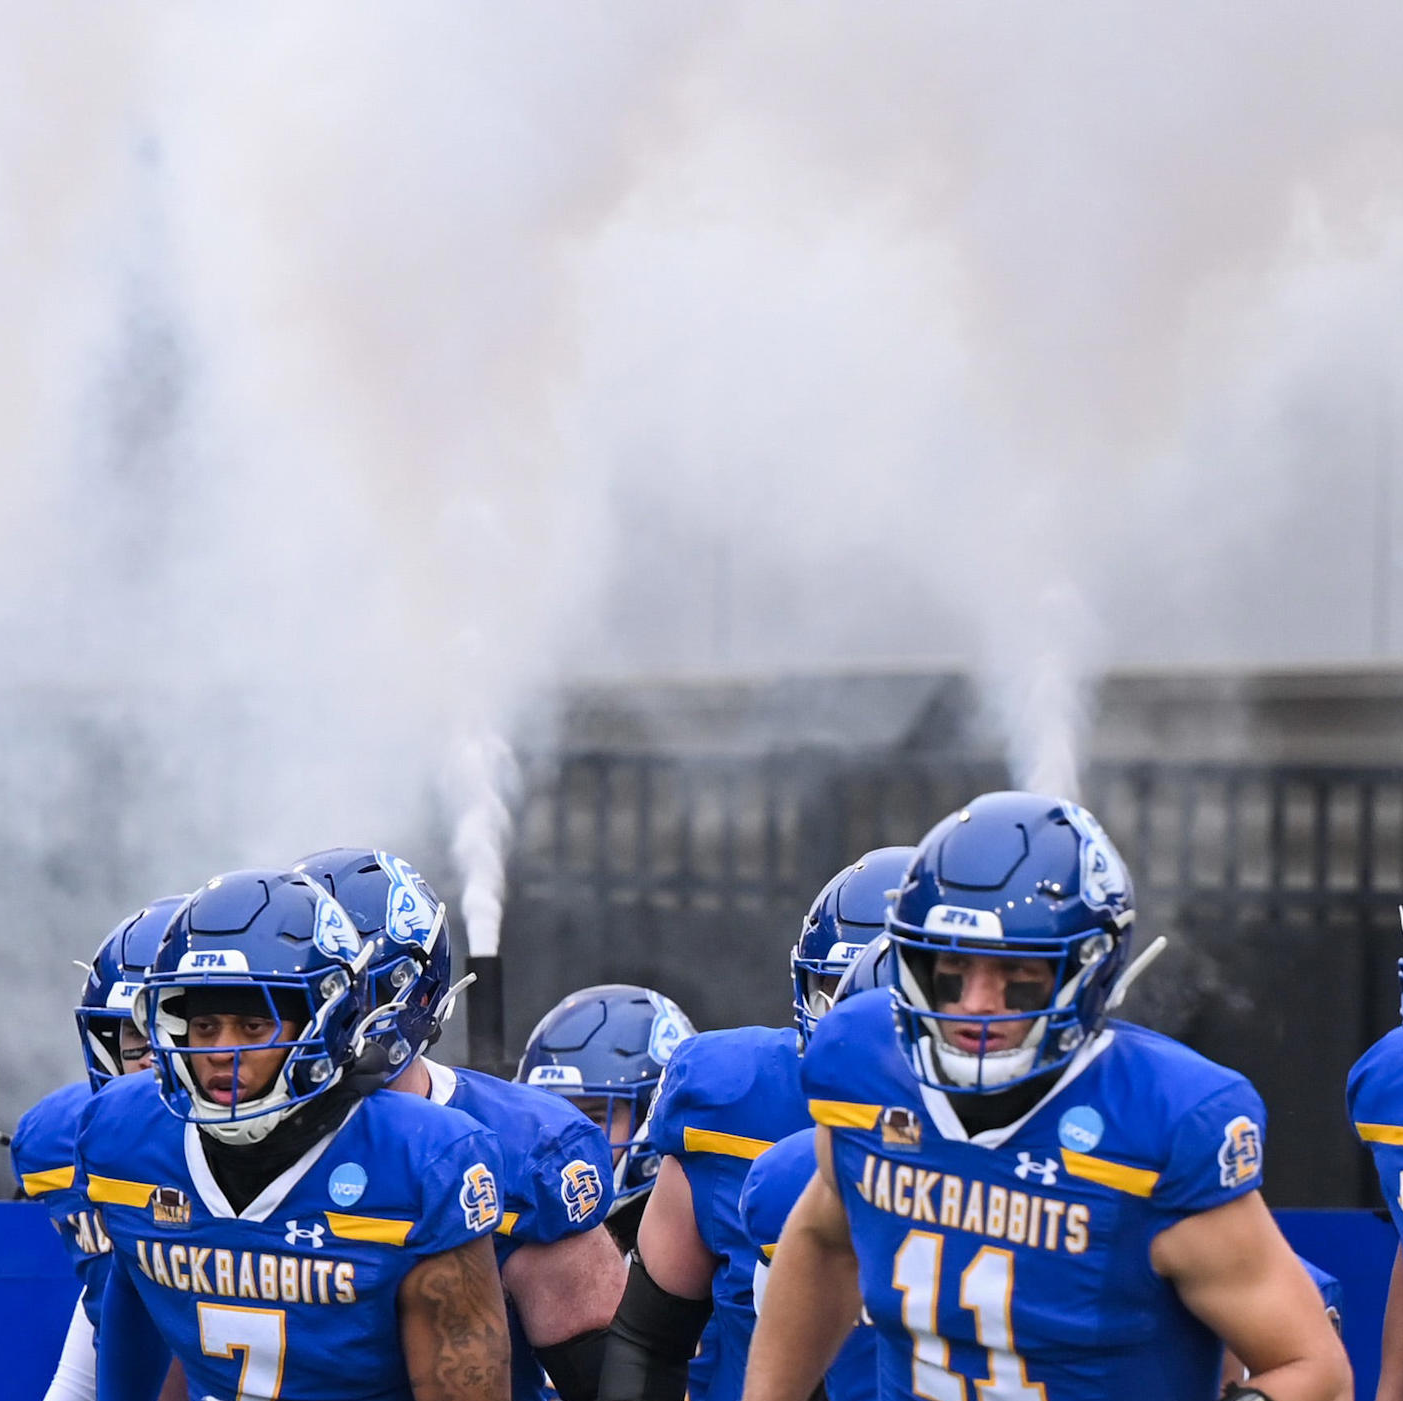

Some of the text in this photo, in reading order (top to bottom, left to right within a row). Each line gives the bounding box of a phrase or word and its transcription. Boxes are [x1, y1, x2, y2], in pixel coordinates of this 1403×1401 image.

[191, 954, 226, 967] JFPA
[856, 1155, 1090, 1254] JACKRABBITS
[137, 1240, 357, 1304] JACKRABBITS
